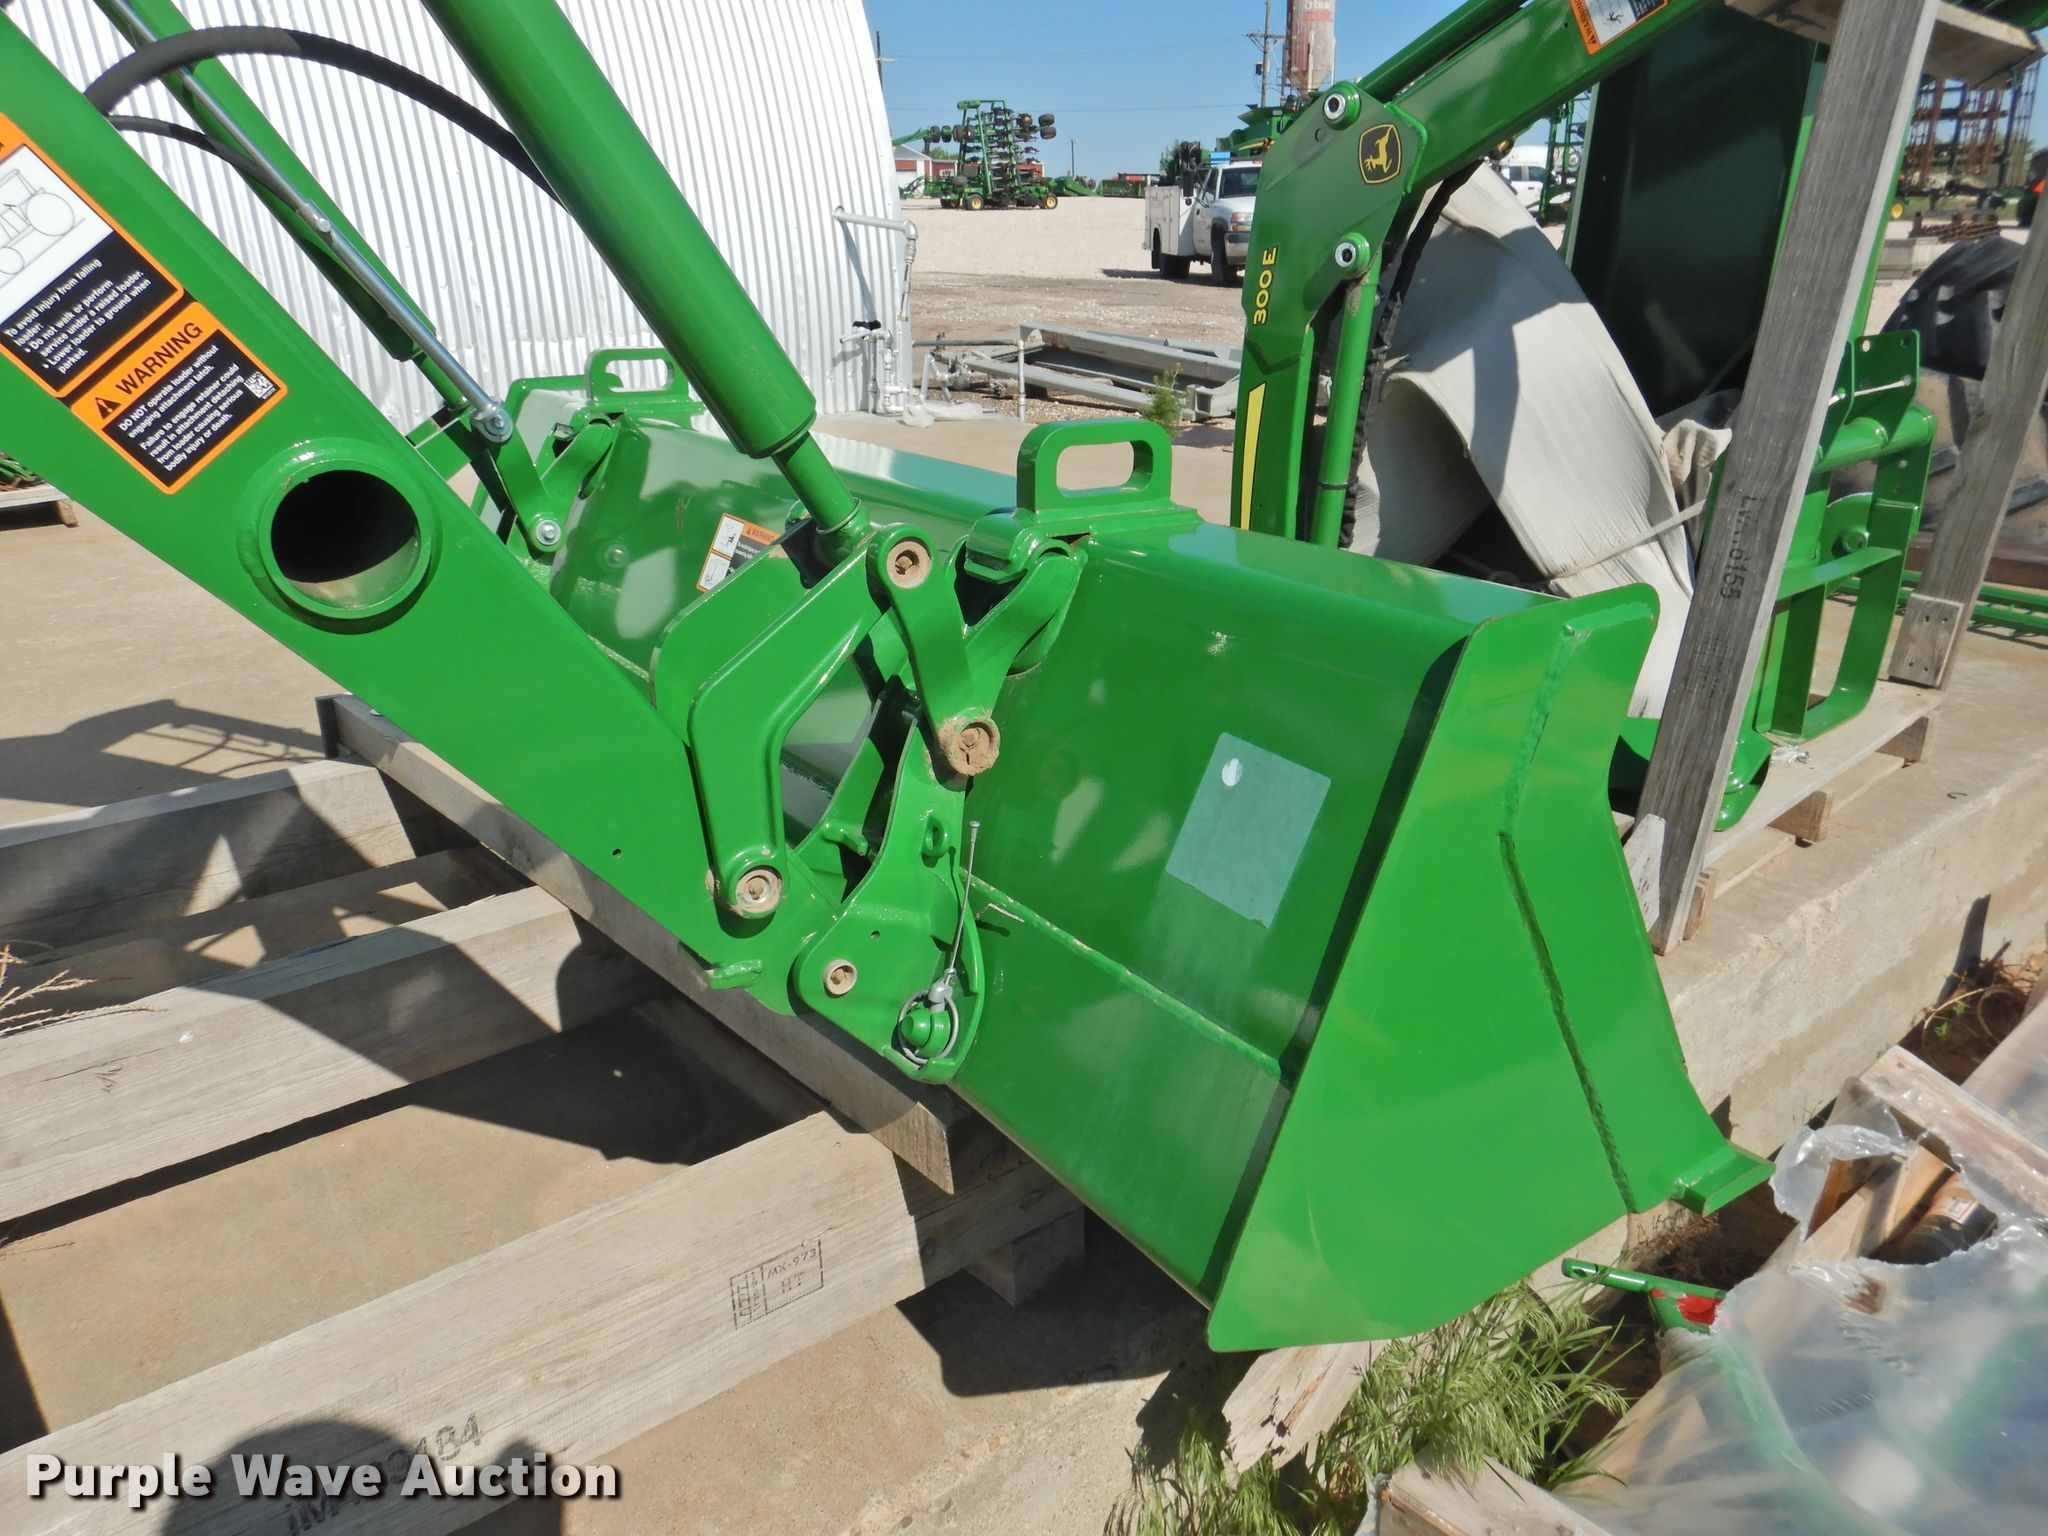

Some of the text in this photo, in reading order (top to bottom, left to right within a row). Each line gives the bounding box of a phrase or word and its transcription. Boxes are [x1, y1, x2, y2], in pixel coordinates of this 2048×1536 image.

[4, 259, 102, 337] To avoid injury from falling
[14, 323, 44, 346] loader:
[30, 280, 113, 350] Do not walk or perform
[40, 333, 69, 357] service
[67, 315, 89, 335] under
[94, 290, 119, 310] raised
[117, 271, 144, 292] loader.
[48, 279, 151, 366] Lower loader to ground when
[58, 347, 88, 374] parked.
[116, 322, 203, 395] WARNING
[118, 345, 219, 432] DO NOT operate loader without
[128, 365, 215, 438] engaging attachment latch.
[140, 364, 239, 450] Failure to engage retainer could
[149, 439, 171, 457] result
[169, 433, 176, 442] in
[174, 403, 213, 437] attachment
[211, 375, 244, 404] detaching
[157, 449, 175, 465] from
[173, 431, 195, 451] loader
[194, 410, 222, 433] causing
[219, 390, 243, 412] serious
[164, 413, 233, 471] bodily injury or death.
[767, 1248, 818, 1279] MX-973
